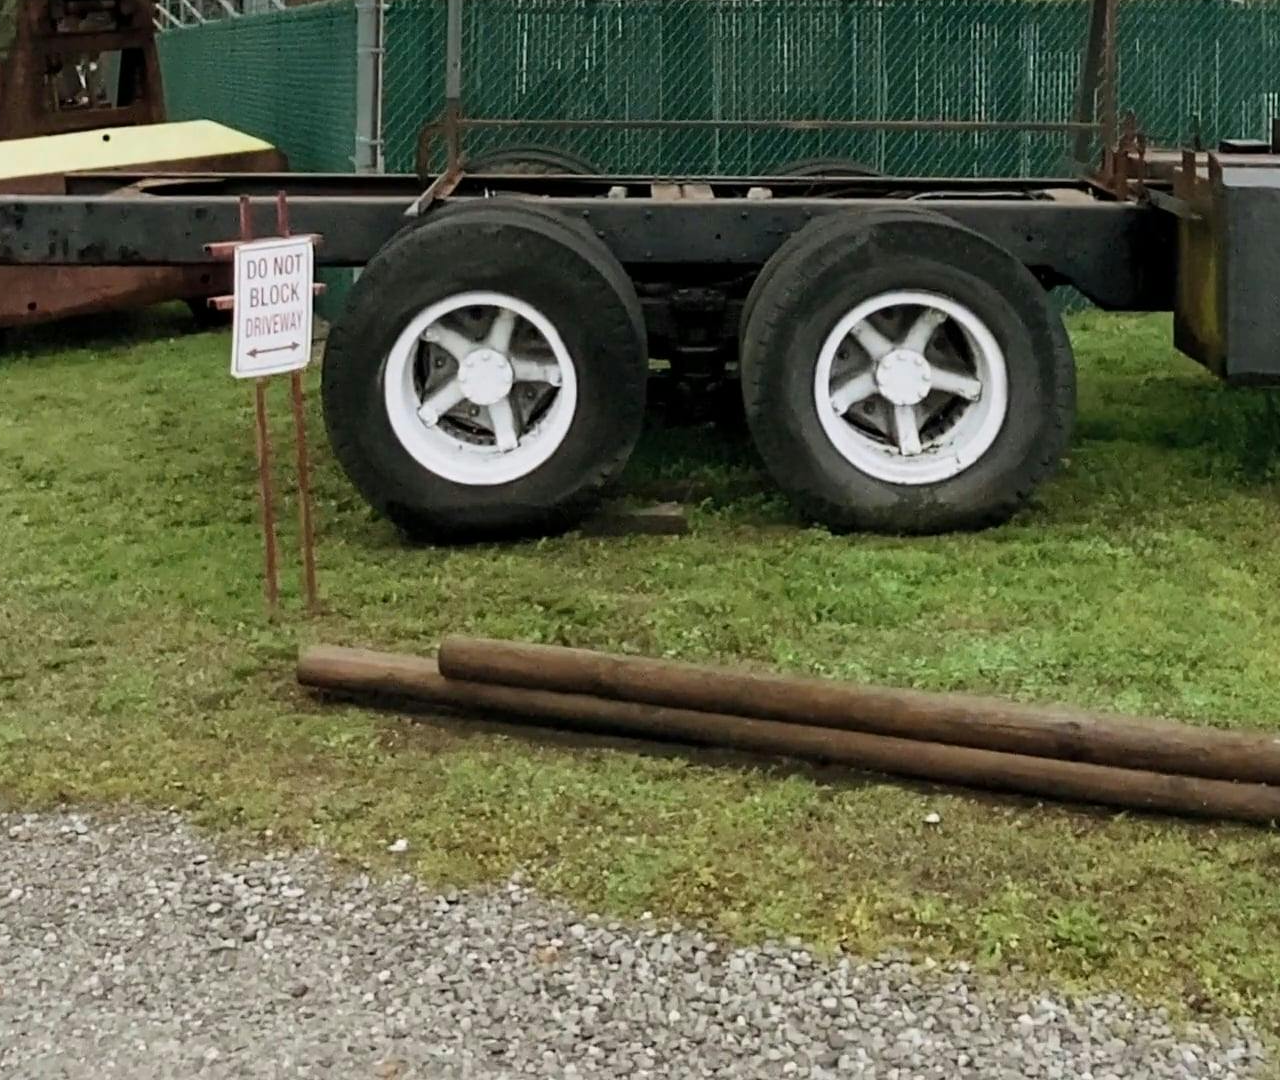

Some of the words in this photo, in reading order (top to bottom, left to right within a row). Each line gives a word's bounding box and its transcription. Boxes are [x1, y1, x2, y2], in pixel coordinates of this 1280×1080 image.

[247, 258, 267, 279] DO
[273, 254, 302, 275] NOT
[250, 283, 300, 308] BLOCK
[246, 311, 302, 338] DRIVEWAY
